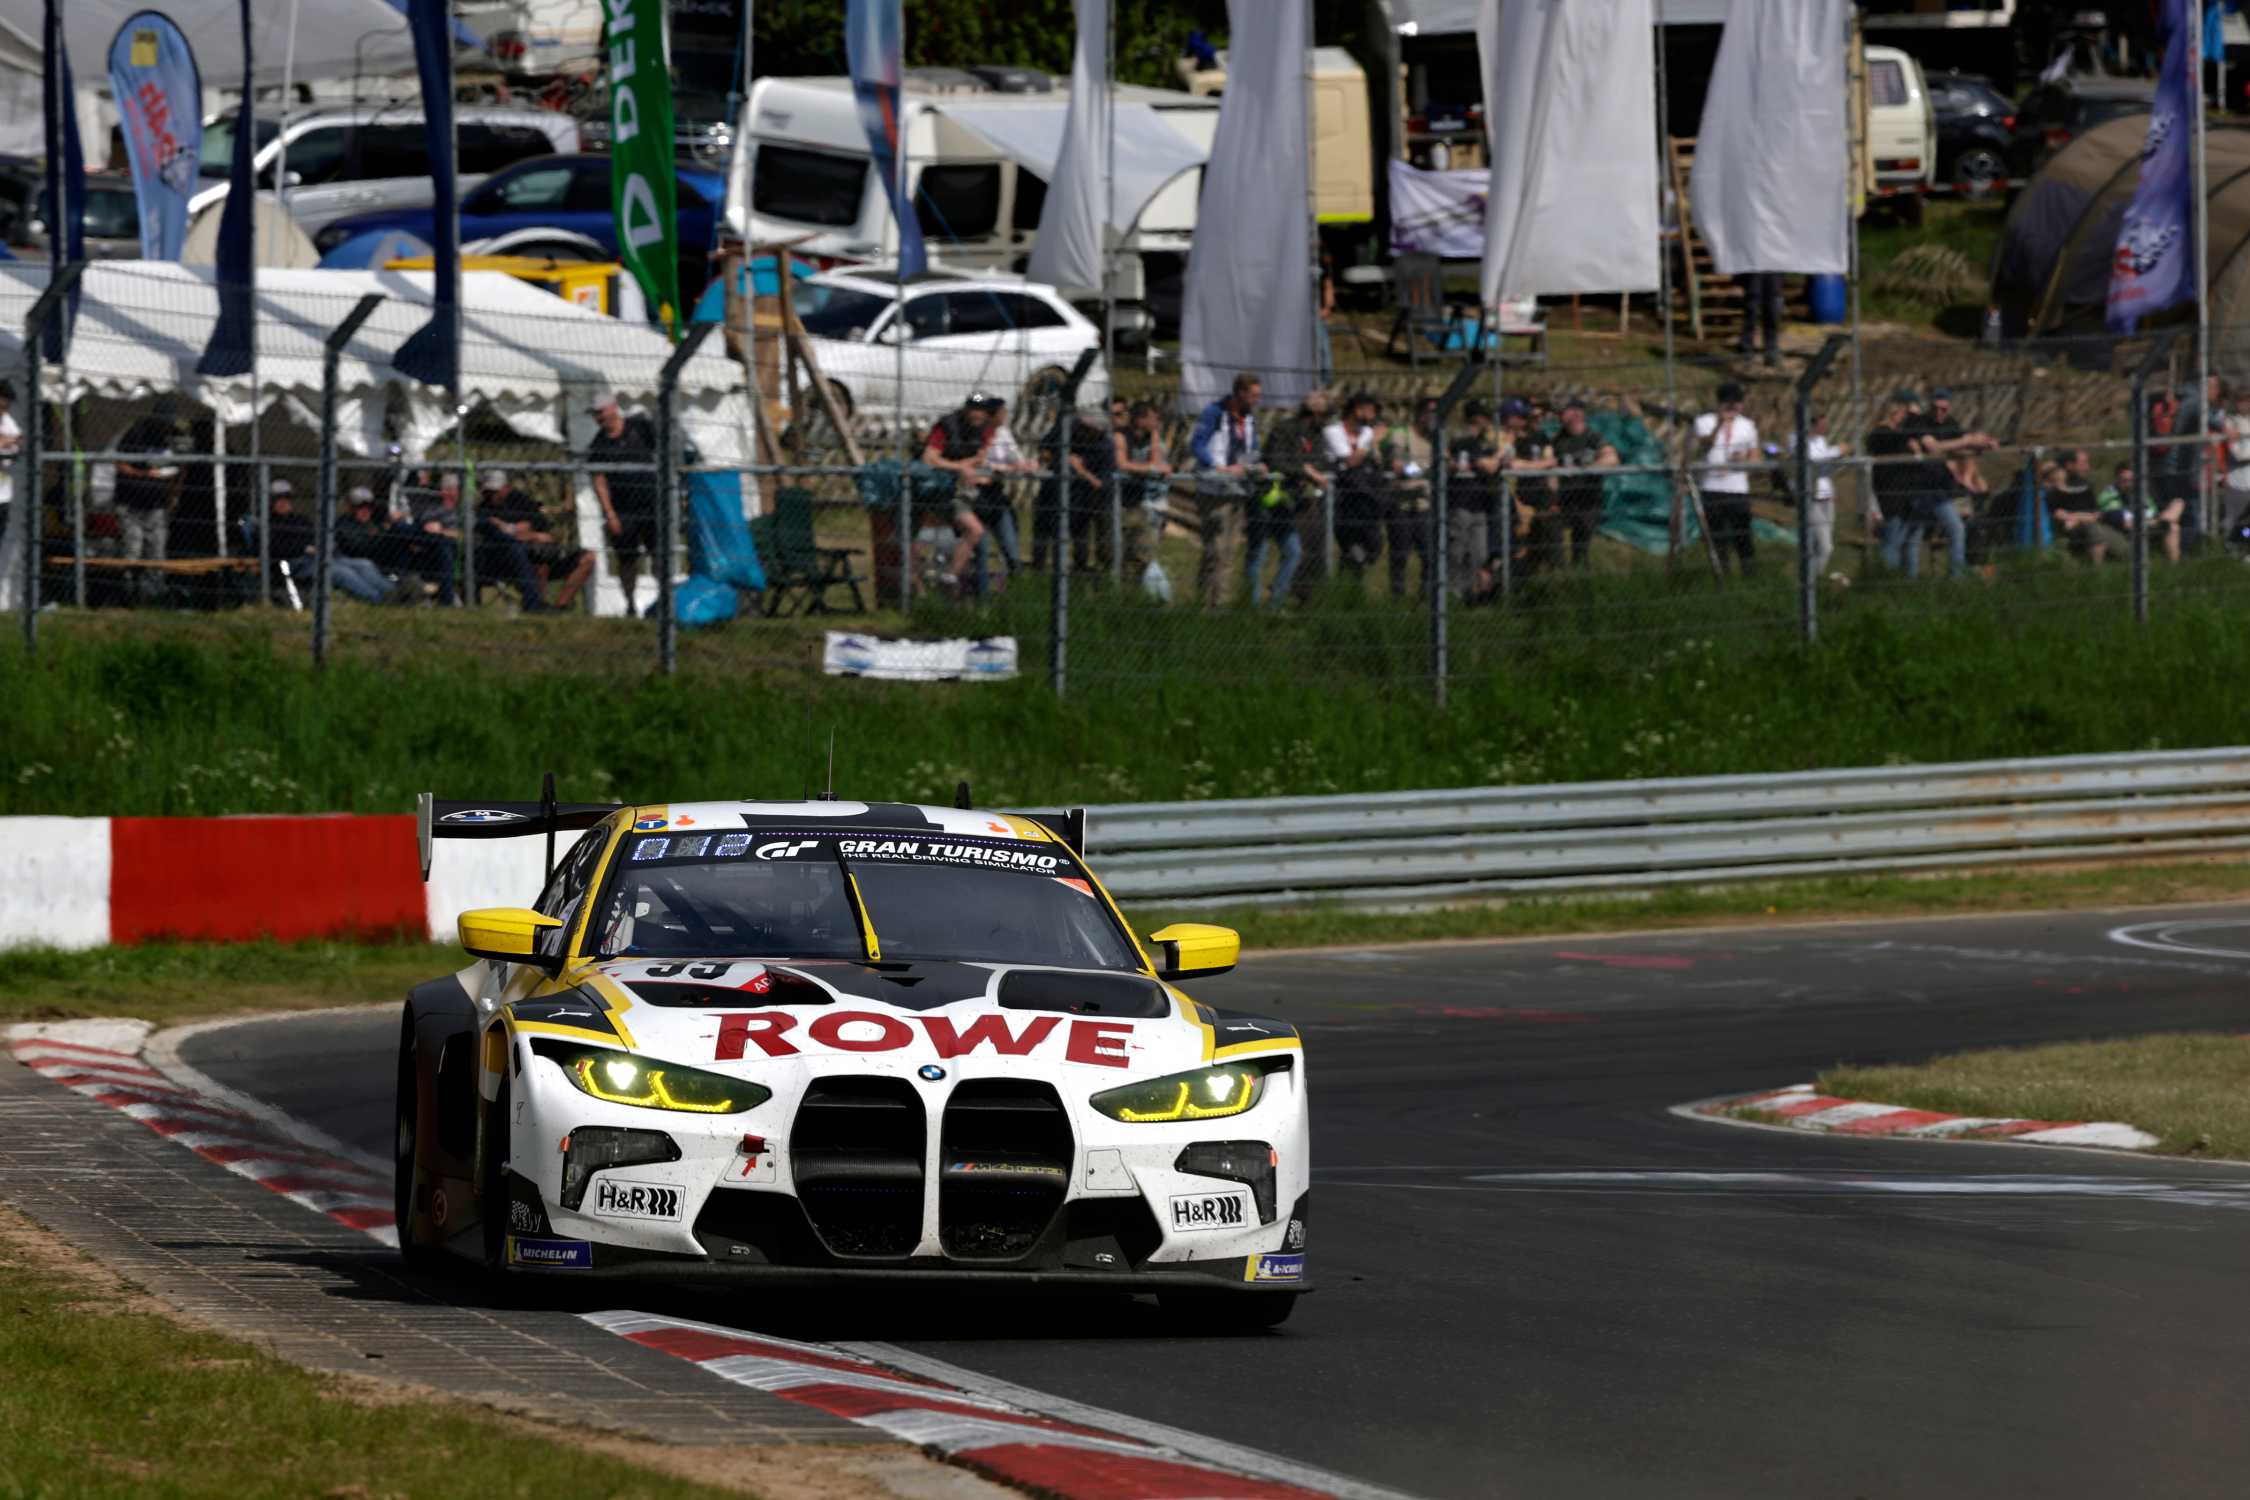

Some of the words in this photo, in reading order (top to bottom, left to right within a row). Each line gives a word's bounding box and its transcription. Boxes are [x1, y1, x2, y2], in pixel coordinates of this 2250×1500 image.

[838, 840, 920, 855] GRAN
[871, 852, 911, 860] REAL
[912, 854, 971, 864] DRIVING
[974, 859, 1057, 875] SIMULATOR
[703, 1010, 1135, 1069] ROWE
[598, 1184, 646, 1212] H&R
[1173, 1198, 1218, 1224] H&R
[523, 1247, 578, 1260] MICHELIN
